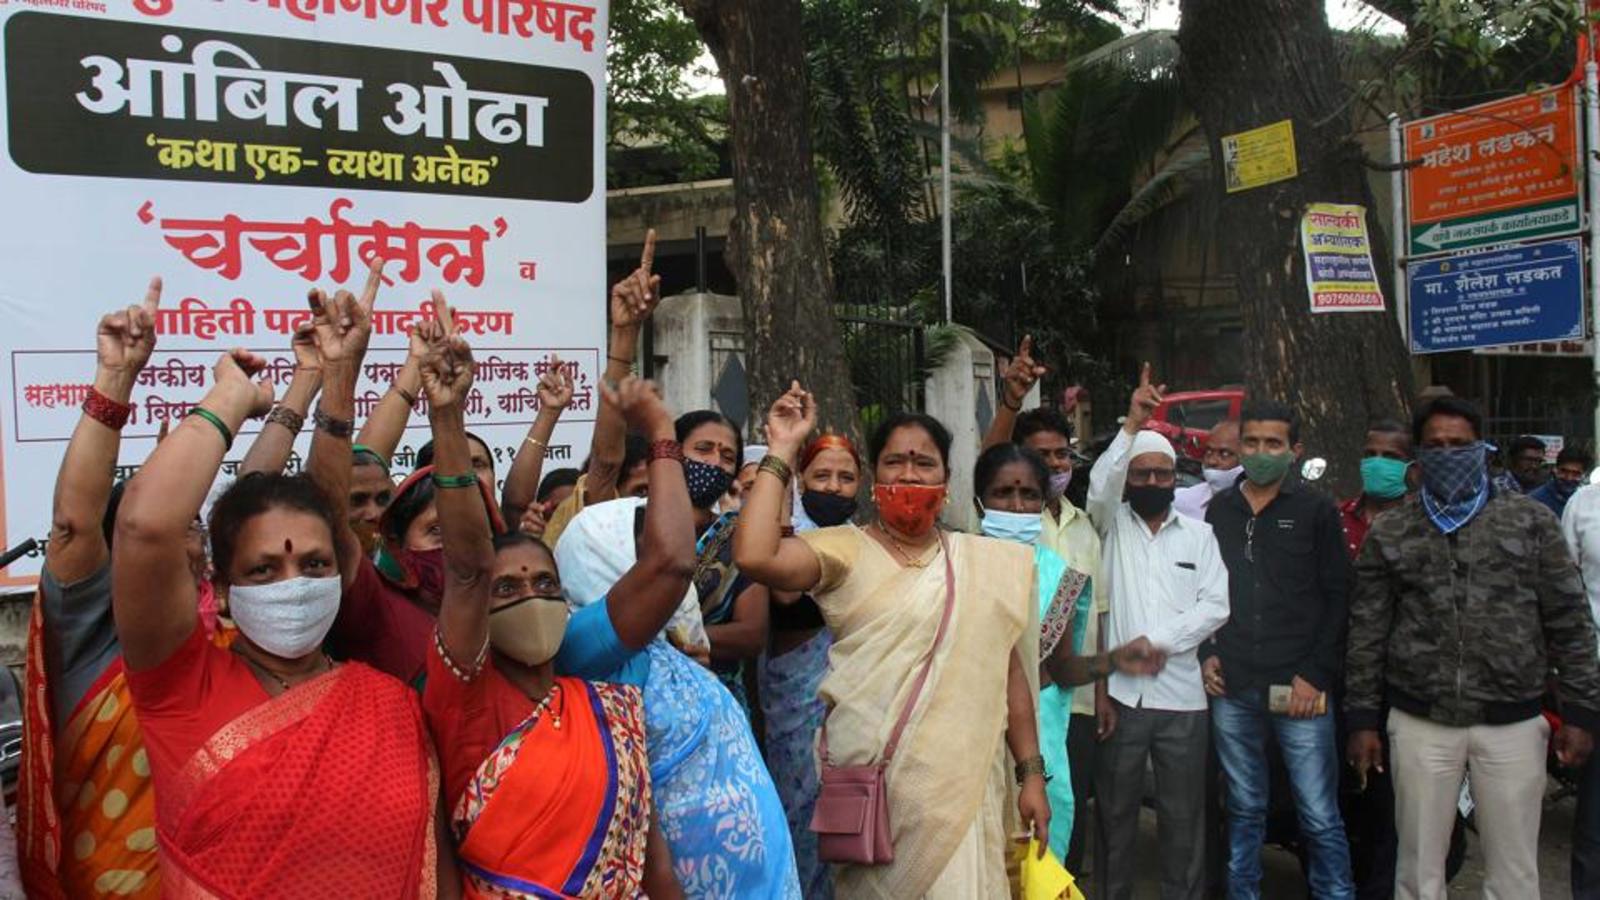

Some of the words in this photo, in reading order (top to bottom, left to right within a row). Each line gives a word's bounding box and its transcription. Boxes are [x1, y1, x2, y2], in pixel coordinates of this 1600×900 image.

[76, 35, 362, 131] आंबिल
[382, 61, 548, 147] ओढा
[326, 149, 403, 181] व्यथा
[1501, 208, 1570, 231] कार्यालयाकडे
[519, 260, 536, 281] व
[1424, 281, 1449, 296] मा.
[1455, 272, 1498, 293] शैलेश
[1506, 265, 1563, 285] लडकत
[137, 358, 205, 387] जकीय
[472, 356, 529, 381] माजिक
